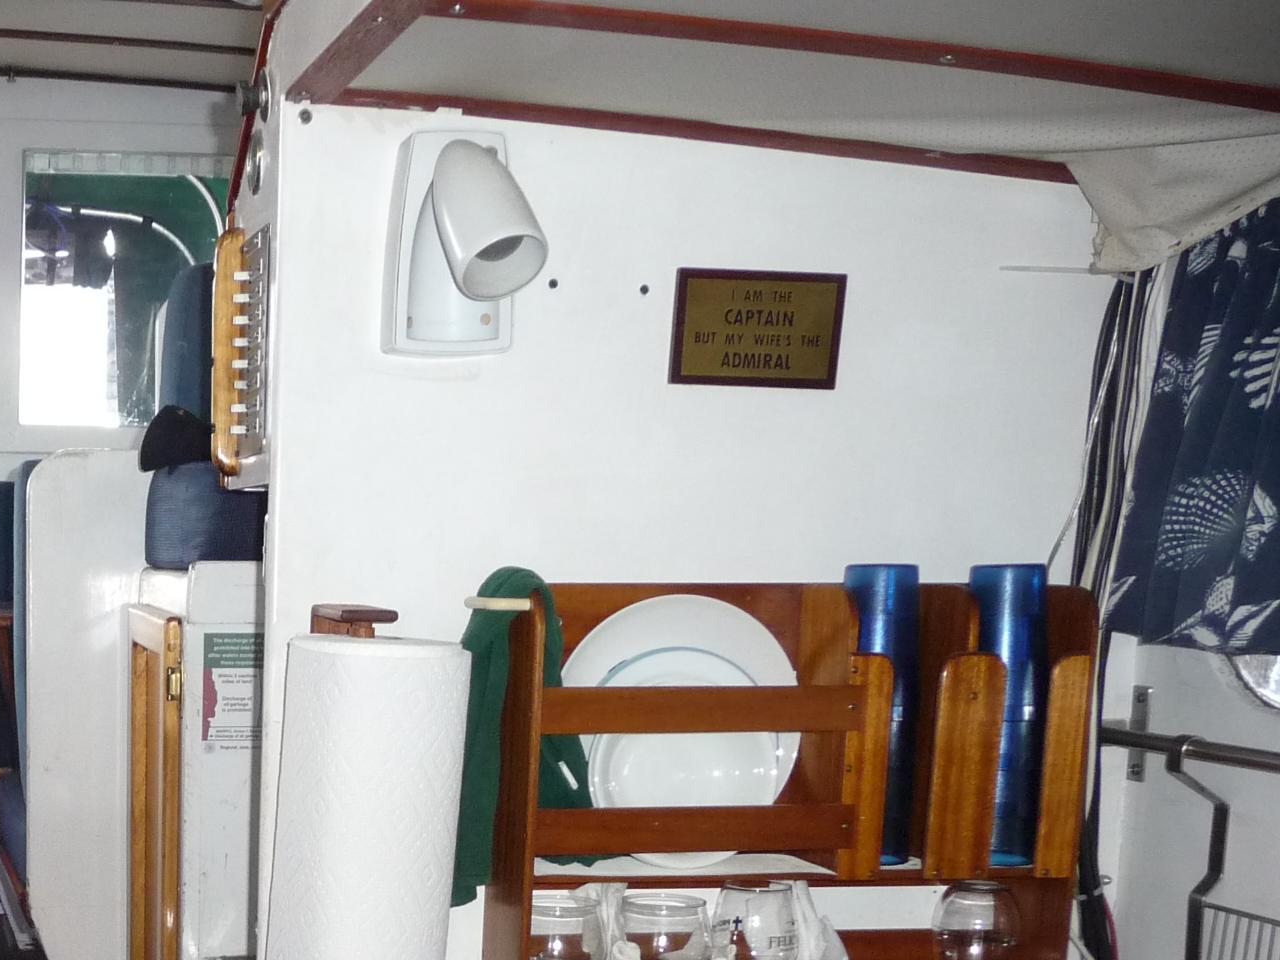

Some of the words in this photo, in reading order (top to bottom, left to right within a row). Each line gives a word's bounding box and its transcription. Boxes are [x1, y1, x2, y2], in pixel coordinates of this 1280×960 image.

[731, 289, 735, 301] I
[744, 290, 763, 303] AM
[773, 290, 793, 303] THE
[724, 308, 795, 327] CAPTAIN
[694, 331, 717, 344] BUT
[725, 333, 743, 345] MY
[754, 333, 791, 347] WIFE'S
[801, 334, 821, 347] THE
[721, 352, 791, 371] ADMIRAL
